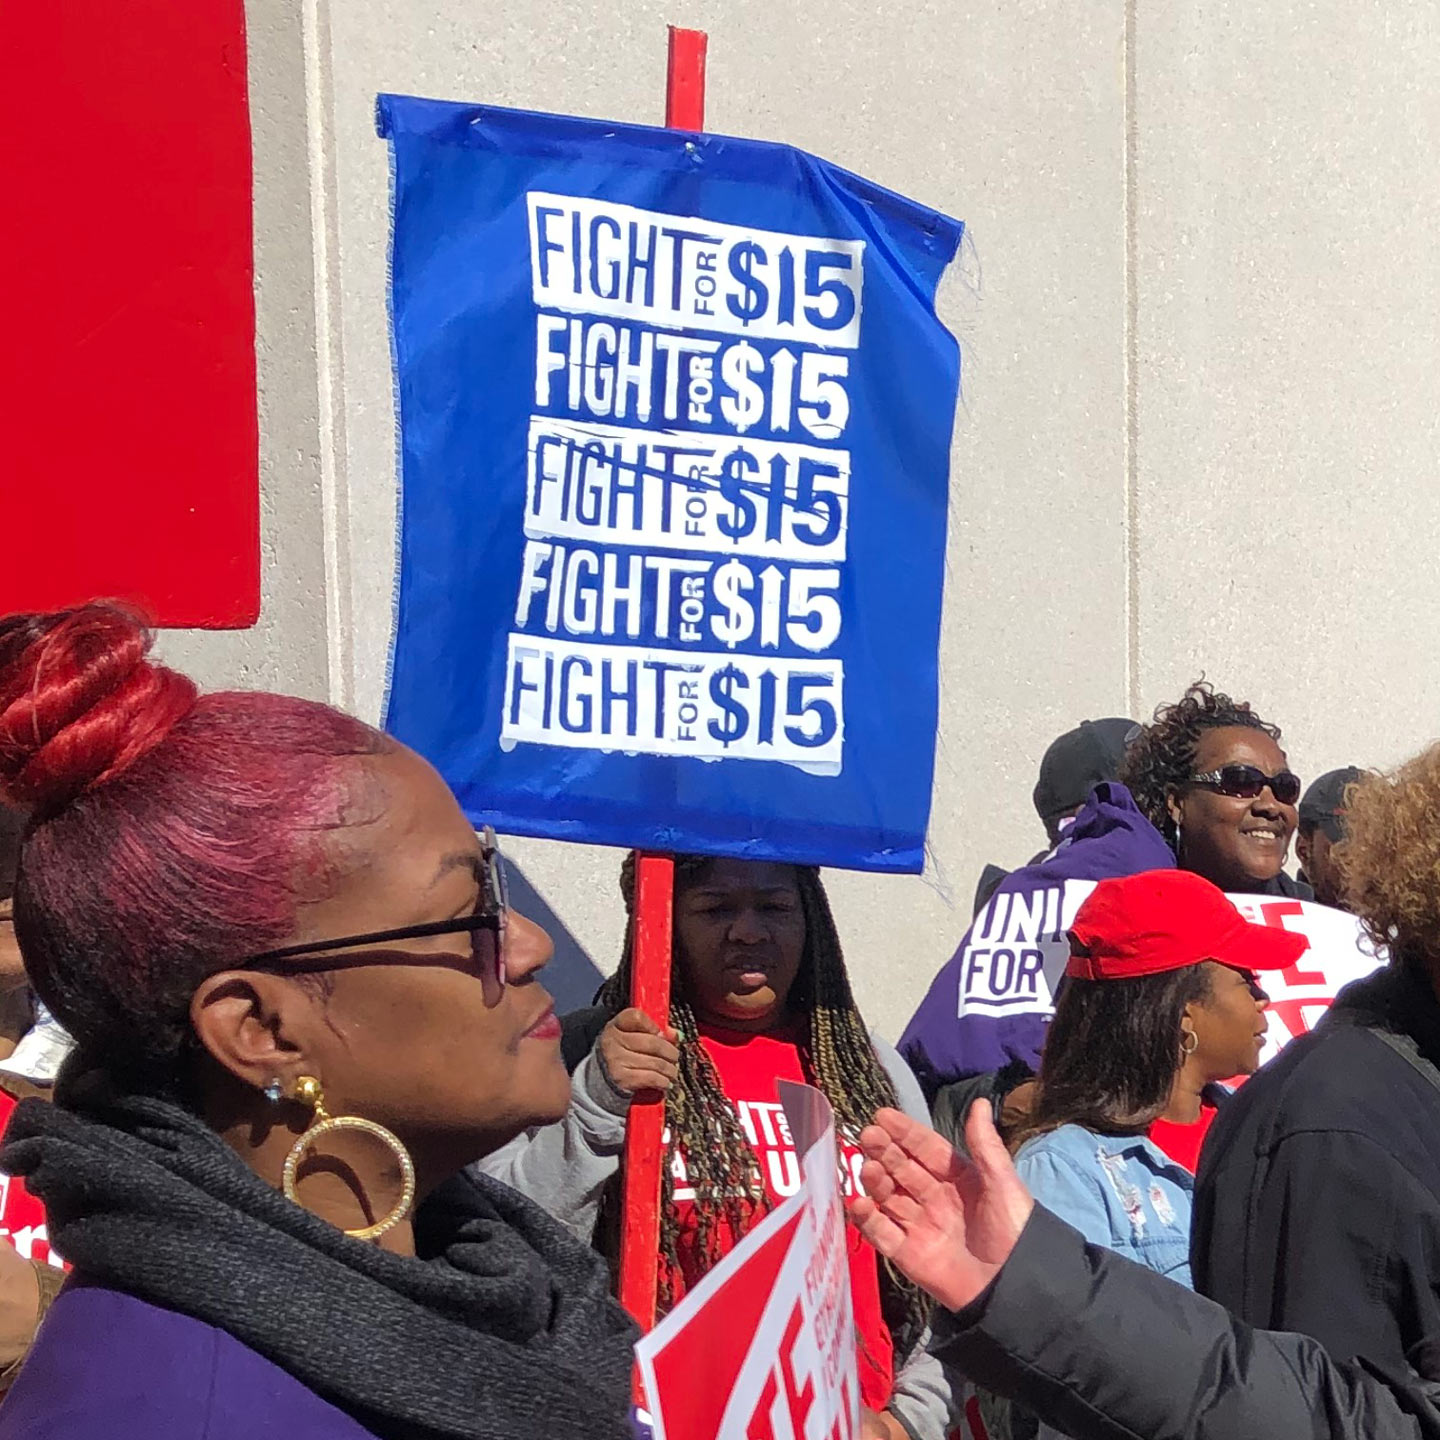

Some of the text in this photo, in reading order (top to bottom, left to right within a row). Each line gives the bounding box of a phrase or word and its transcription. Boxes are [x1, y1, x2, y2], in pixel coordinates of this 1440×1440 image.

[535, 205, 856, 332] FIGHT FOR $15
[534, 313, 850, 440] FIGHT FOR $15
[532, 435, 843, 546] FIGHT FOR $15
[515, 540, 842, 653] FIGHT FOR $15
[509, 646, 838, 749] FIGHT FOR $15
[965, 949, 1044, 996] FOR
